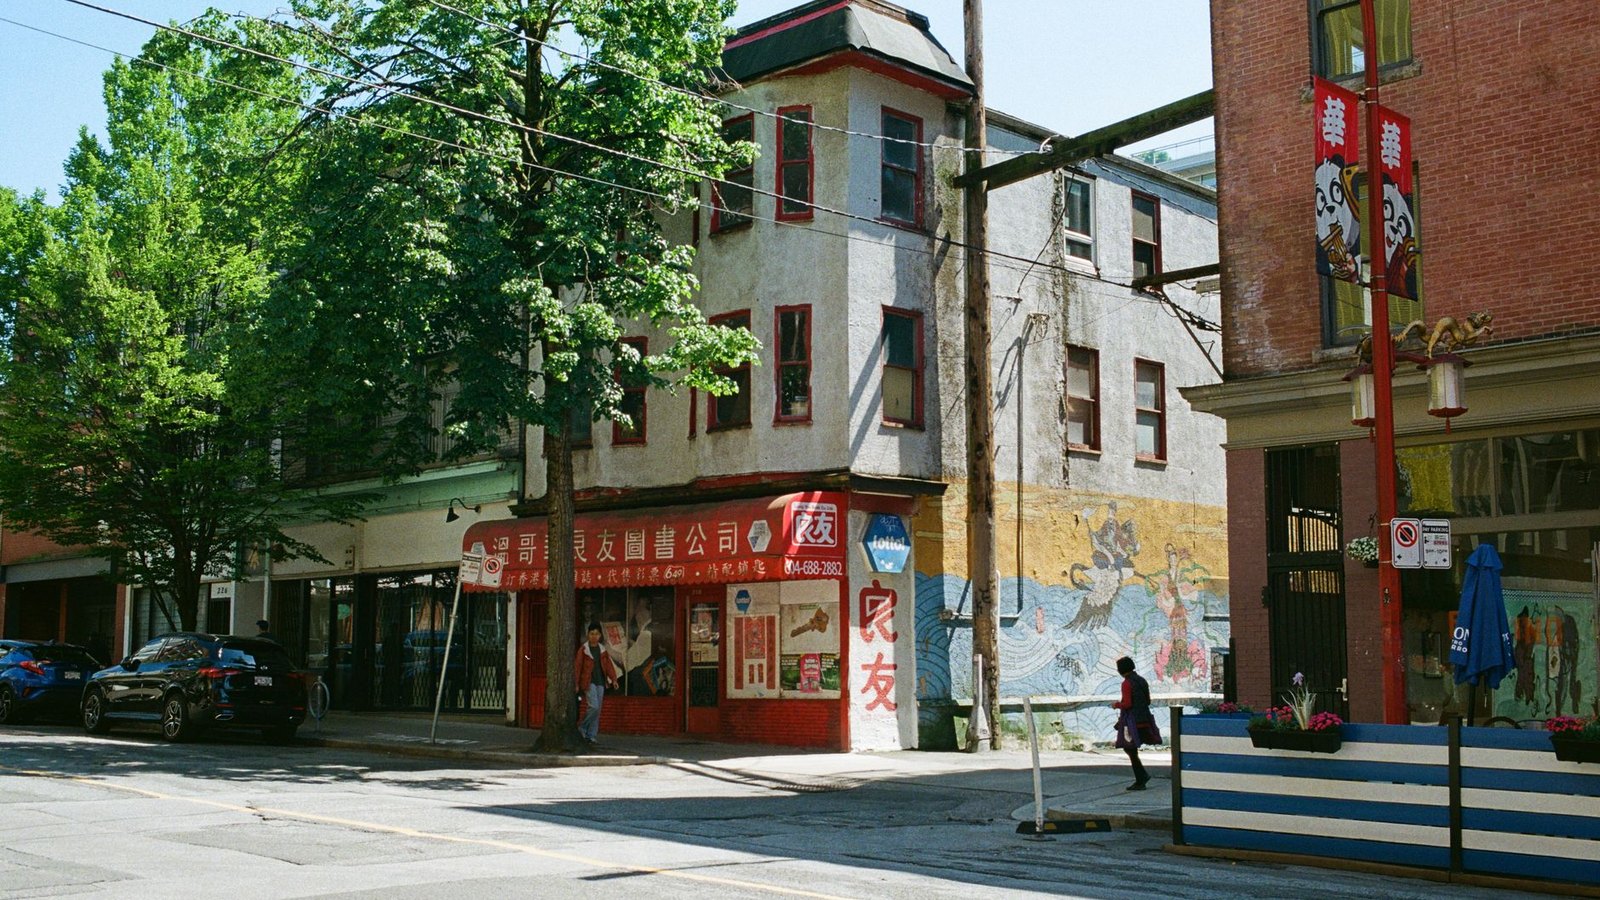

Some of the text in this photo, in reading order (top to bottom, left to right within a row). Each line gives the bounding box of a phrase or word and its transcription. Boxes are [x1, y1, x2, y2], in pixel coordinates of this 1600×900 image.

[492, 522, 738, 566] 溫哥良友圖書公司
[795, 512, 834, 544] 良友
[858, 579, 898, 712] 良友
